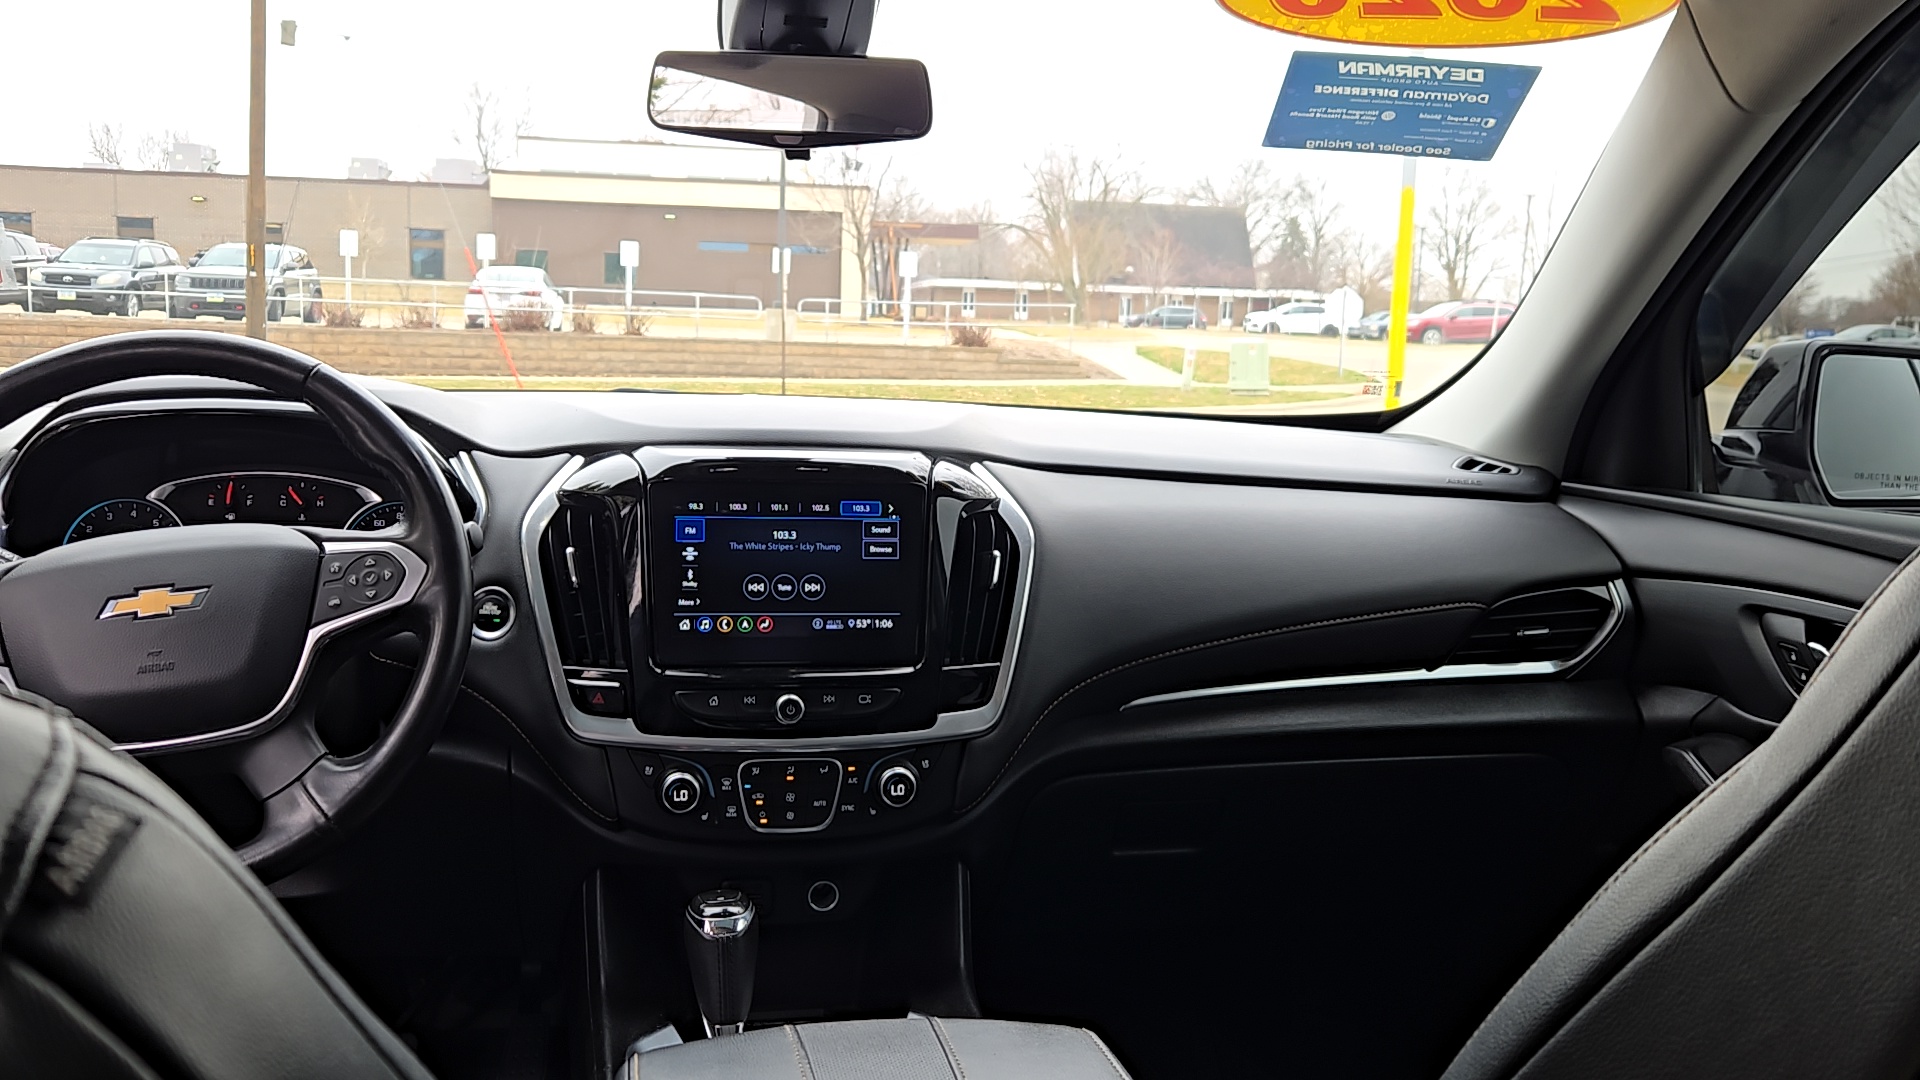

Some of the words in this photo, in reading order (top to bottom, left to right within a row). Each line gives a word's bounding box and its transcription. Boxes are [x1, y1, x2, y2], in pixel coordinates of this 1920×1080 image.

[1854, 472, 1890, 481] OBJECTS
[688, 502, 704, 510] 98.3
[729, 503, 748, 511] 100.3
[771, 503, 788, 511] 101.1
[853, 504, 870, 512] 103.3
[130, 510, 137, 518] 4
[152, 519, 160, 527] 5
[374, 519, 386, 527] 60
[86, 525, 93, 533] 2
[685, 526, 697, 535] FM
[871, 526, 891, 534] Sound
[773, 530, 797, 540] 103.3
[729, 542, 743, 550] The
[744, 542, 767, 551] White
[767, 542, 794, 552] Stripes
[800, 543, 815, 552] Icky
[816, 543, 841, 552] Thump
[869, 545, 893, 553] Browse
[678, 598, 695, 606] More
[875, 618, 894, 629] 1:06
[136, 661, 175, 675] AIRBAG
[891, 783, 905, 796] LO
[674, 789, 689, 802] LO
[841, 804, 855, 812] SYNC
